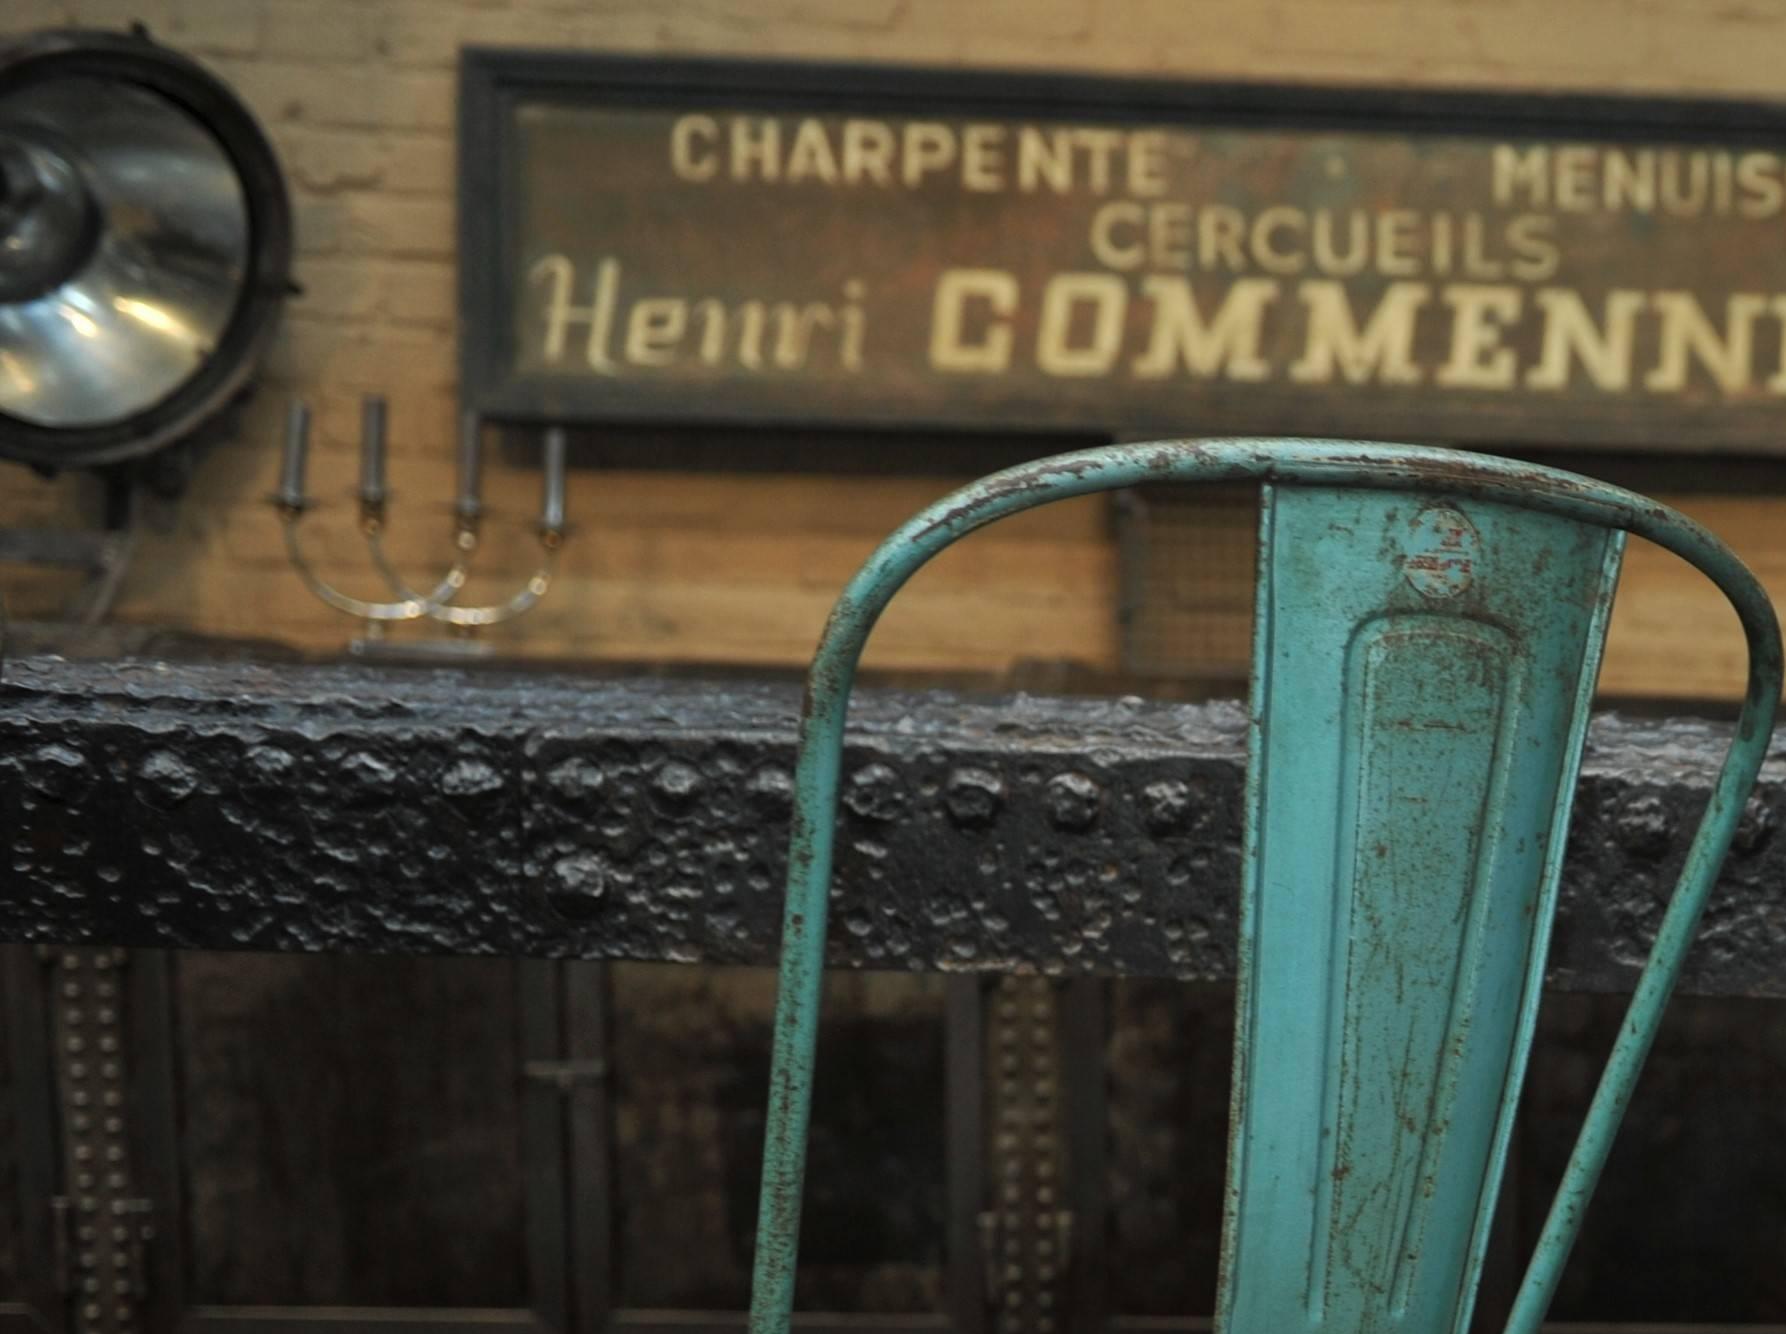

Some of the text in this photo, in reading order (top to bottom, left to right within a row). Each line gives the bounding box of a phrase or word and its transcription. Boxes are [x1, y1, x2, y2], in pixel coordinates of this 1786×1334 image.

[670, 114, 1168, 193] CHARPENTE
[1090, 202, 1559, 279] CERCUEILS
[531, 254, 866, 376] Henri
